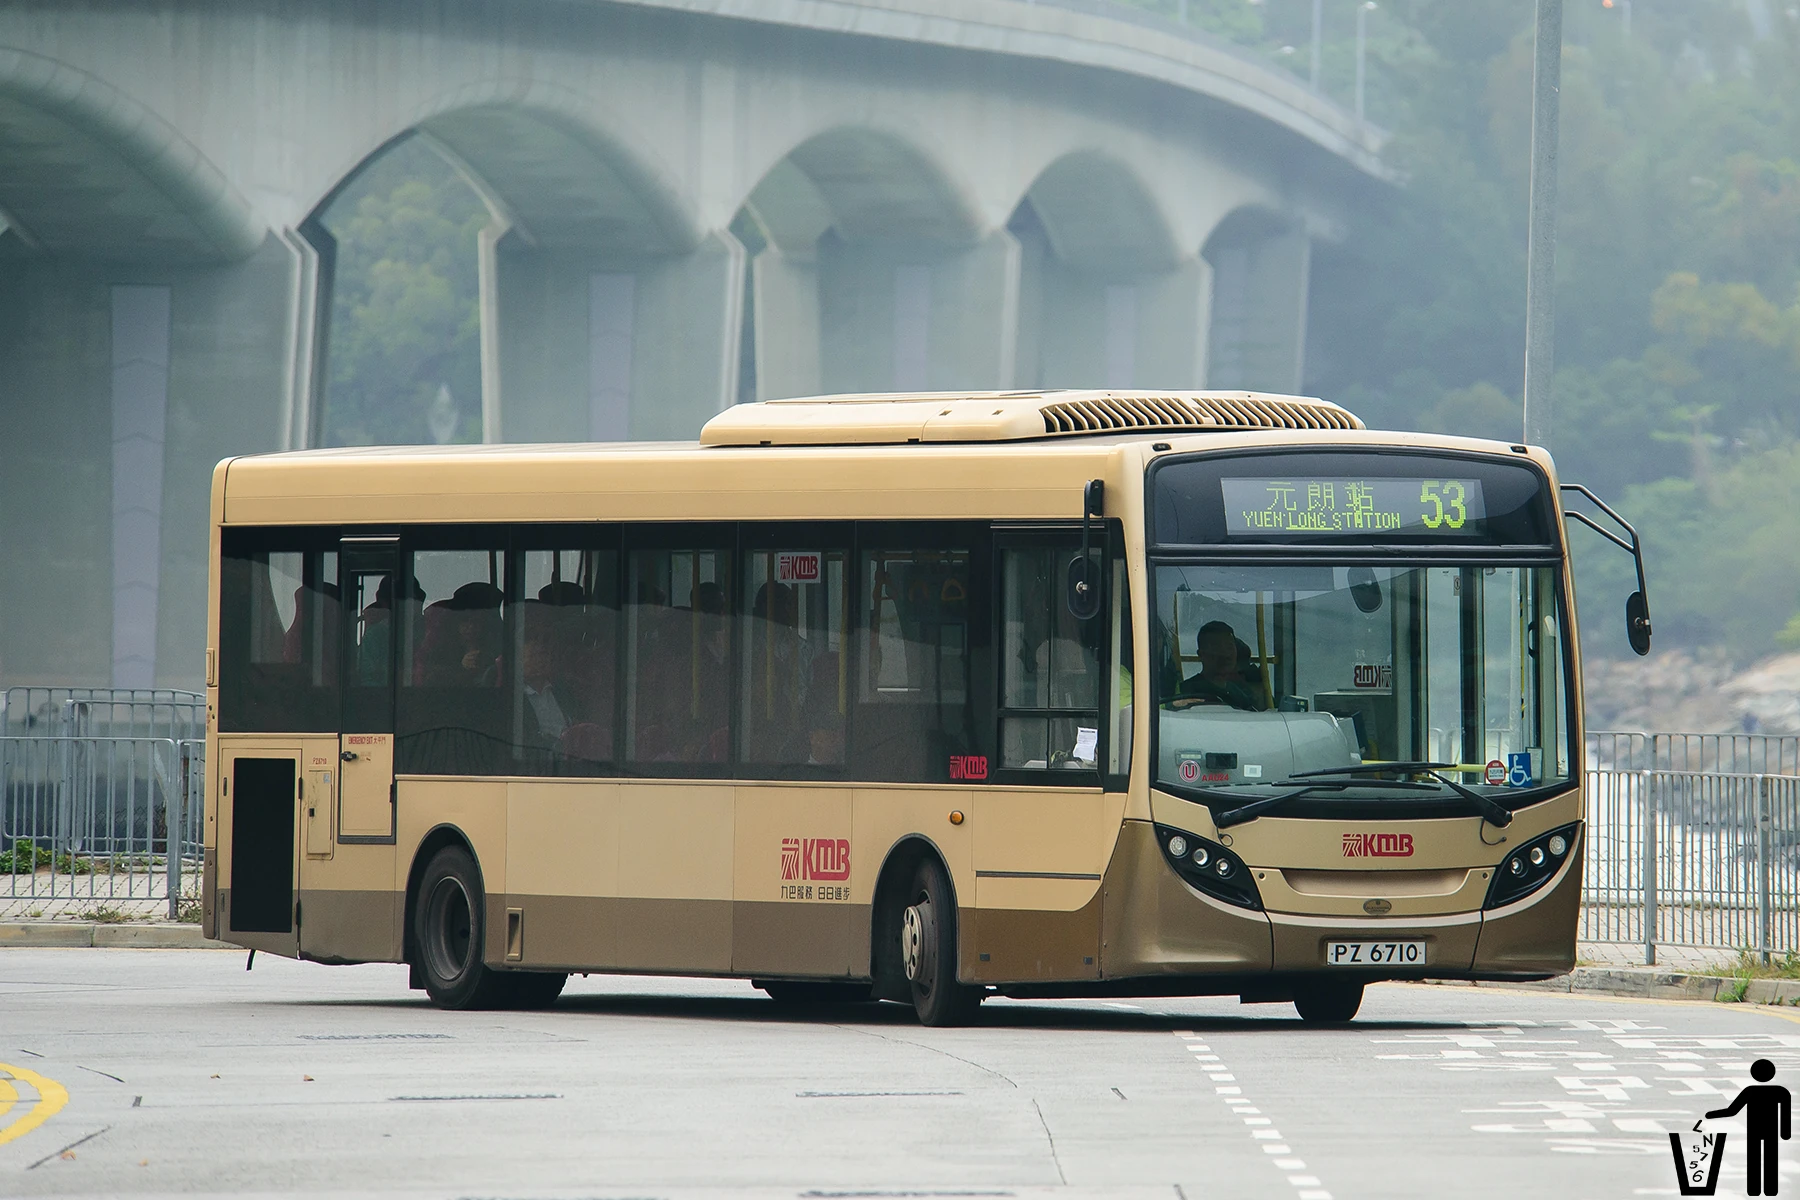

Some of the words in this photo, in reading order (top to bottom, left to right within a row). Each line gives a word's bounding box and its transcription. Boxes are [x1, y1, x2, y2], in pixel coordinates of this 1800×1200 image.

[1420, 480, 1467, 529] 53
[1243, 511, 1284, 528] YUEN
[1286, 512, 1327, 529] LONG
[1333, 512, 1401, 529] STATION
[791, 555, 818, 580] KMB
[960, 755, 988, 780] KMB
[1362, 833, 1414, 857] KMB
[802, 838, 850, 881] KMB
[818, 886, 850, 901] 日日進步
[1335, 944, 1362, 962] PZ
[1370, 943, 1418, 962] 6710
